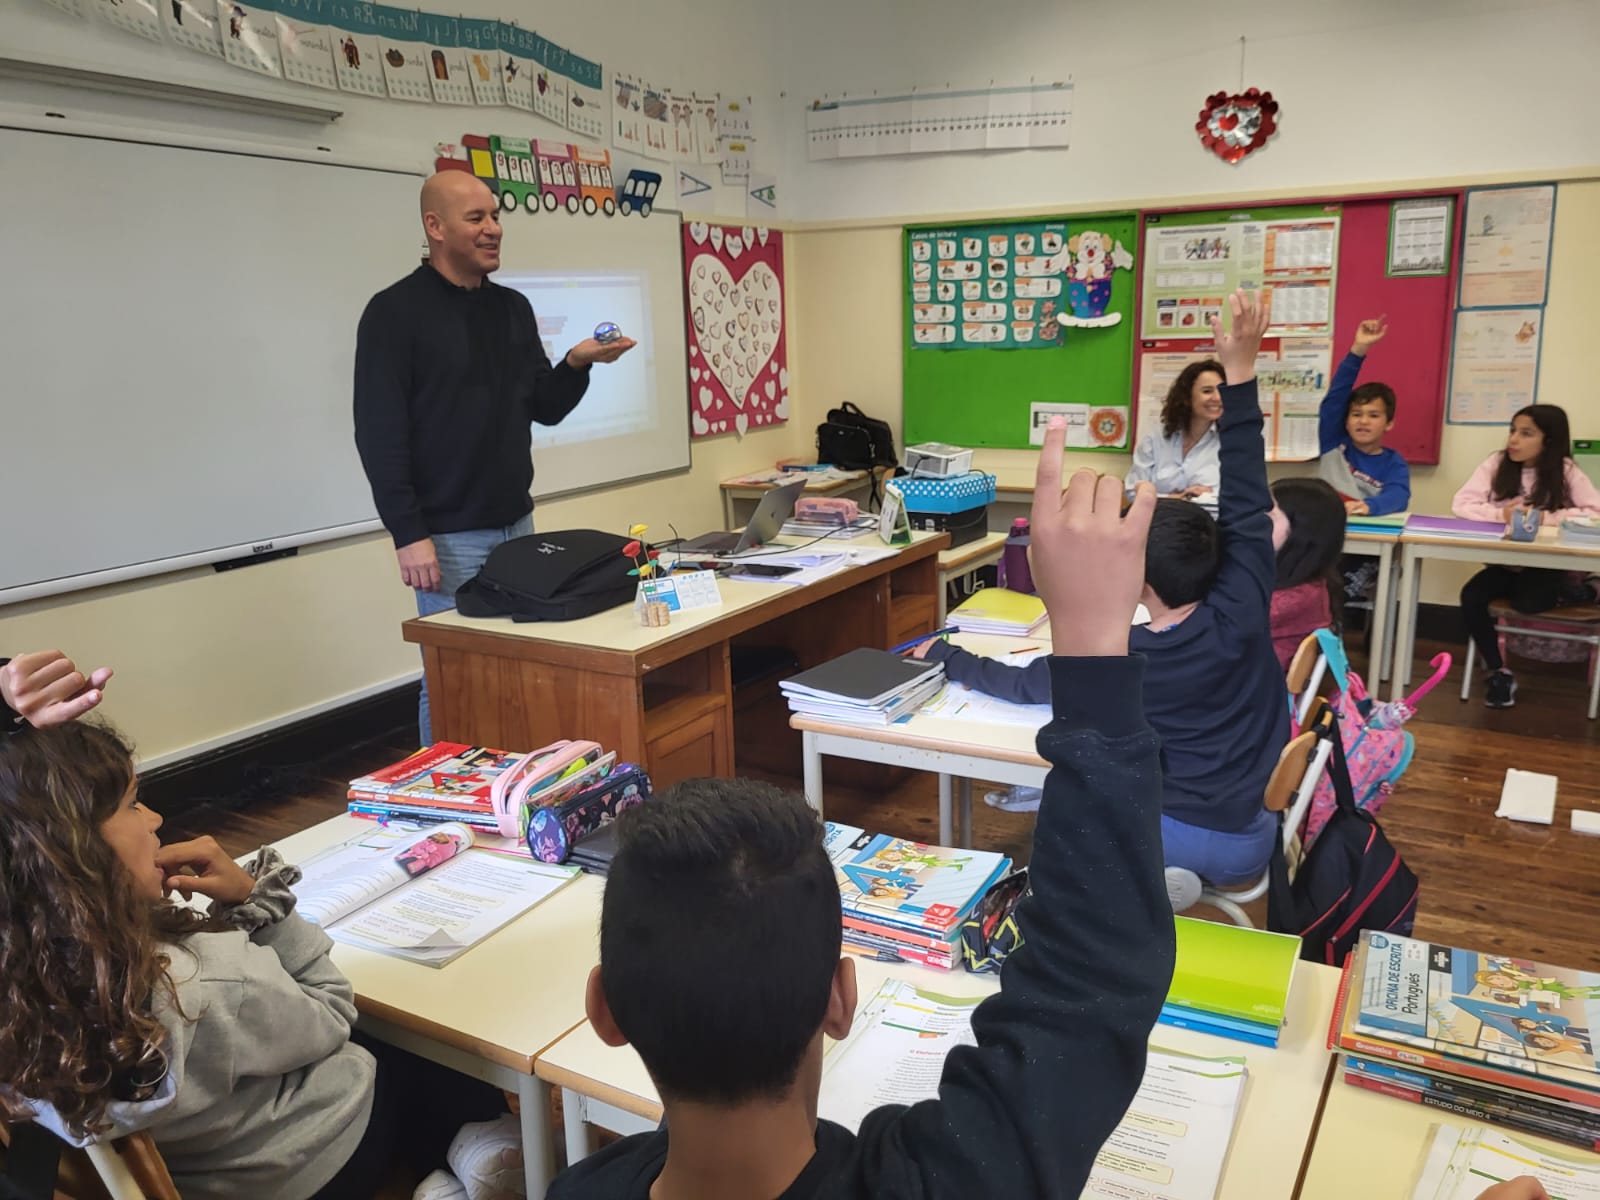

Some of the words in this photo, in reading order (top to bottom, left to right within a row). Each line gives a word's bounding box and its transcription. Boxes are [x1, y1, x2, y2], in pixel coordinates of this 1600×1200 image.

[1390, 943, 1402, 971] ESCRITA
[1388, 972, 1399, 982] DE
[1385, 984, 1397, 1010] OFICINA
[1402, 972, 1423, 1015] Português
[1424, 1097, 1454, 1111] ESTUDO
[1453, 1103, 1465, 1113] DO
